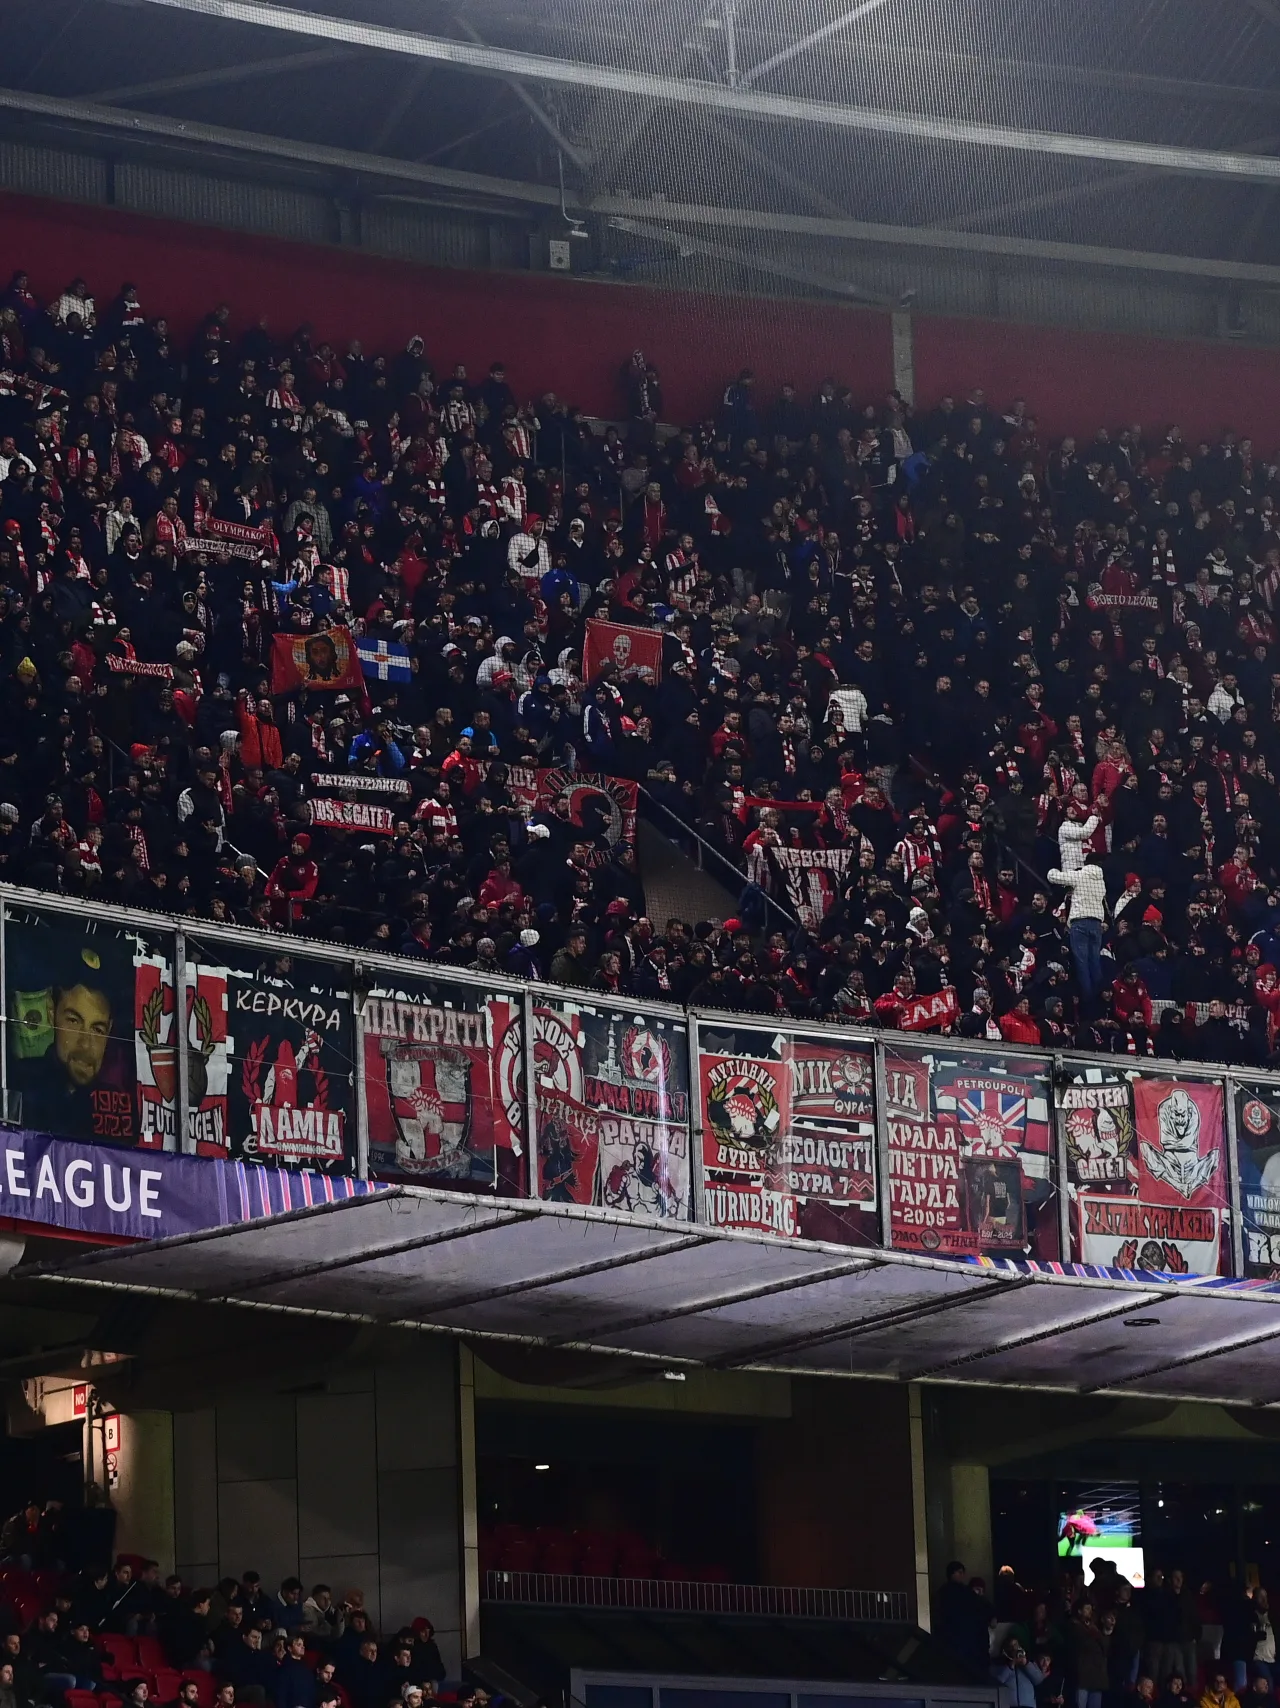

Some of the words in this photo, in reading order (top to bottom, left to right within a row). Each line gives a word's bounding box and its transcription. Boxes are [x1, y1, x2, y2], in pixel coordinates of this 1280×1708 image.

[1092, 594, 1125, 607] PORTO
[1126, 594, 1158, 609] LEONE
[353, 804, 385, 829] GATE
[236, 989, 341, 1031] ΚΕΡΚΥΡΑ
[364, 998, 484, 1049] ΠΑΓΚΡΑΤΙ
[708, 1060, 776, 1091] ΜΥΤΙΛΗΝΗ
[957, 1078, 1025, 1096] PETROUPOLI
[258, 1105, 342, 1156] ΛΑΜΙΑ
[603, 1120, 686, 1159] PATRA
[717, 1147, 758, 1169] ΘΥΡΑ
[1077, 1160, 1115, 1181] GATE
[0, 1151, 163, 1218] EAGUE
[788, 1173, 833, 1195] ΘΥΡΑ
[838, 1175, 850, 1194] 7
[108, 1428, 113, 1440] B
